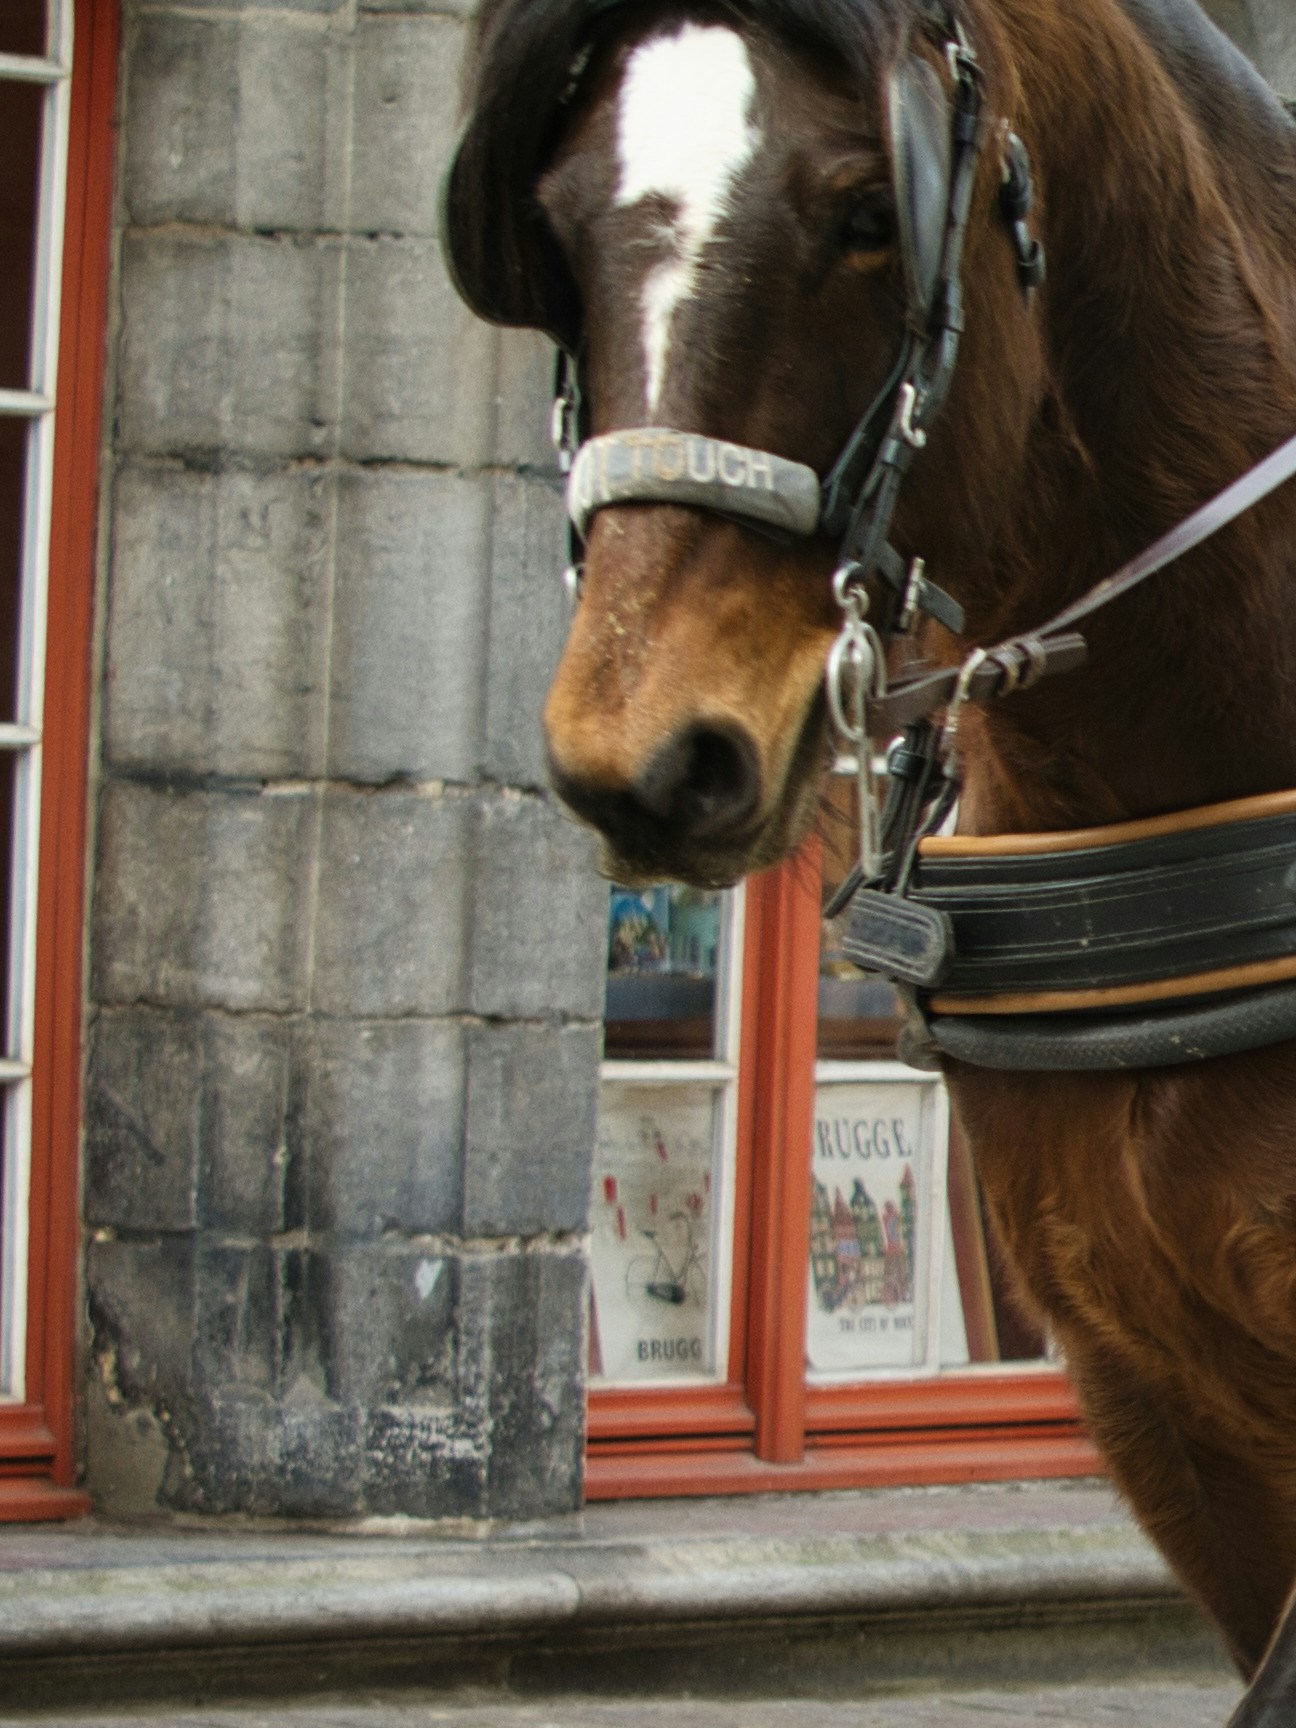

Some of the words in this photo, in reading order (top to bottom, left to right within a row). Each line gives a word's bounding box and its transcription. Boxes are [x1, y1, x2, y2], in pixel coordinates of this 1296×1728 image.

[570, 436, 619, 509] OT
[627, 433, 775, 491] TOUCH
[816, 1118, 913, 1160] RUGGE
[638, 1338, 703, 1361] BRUGG
